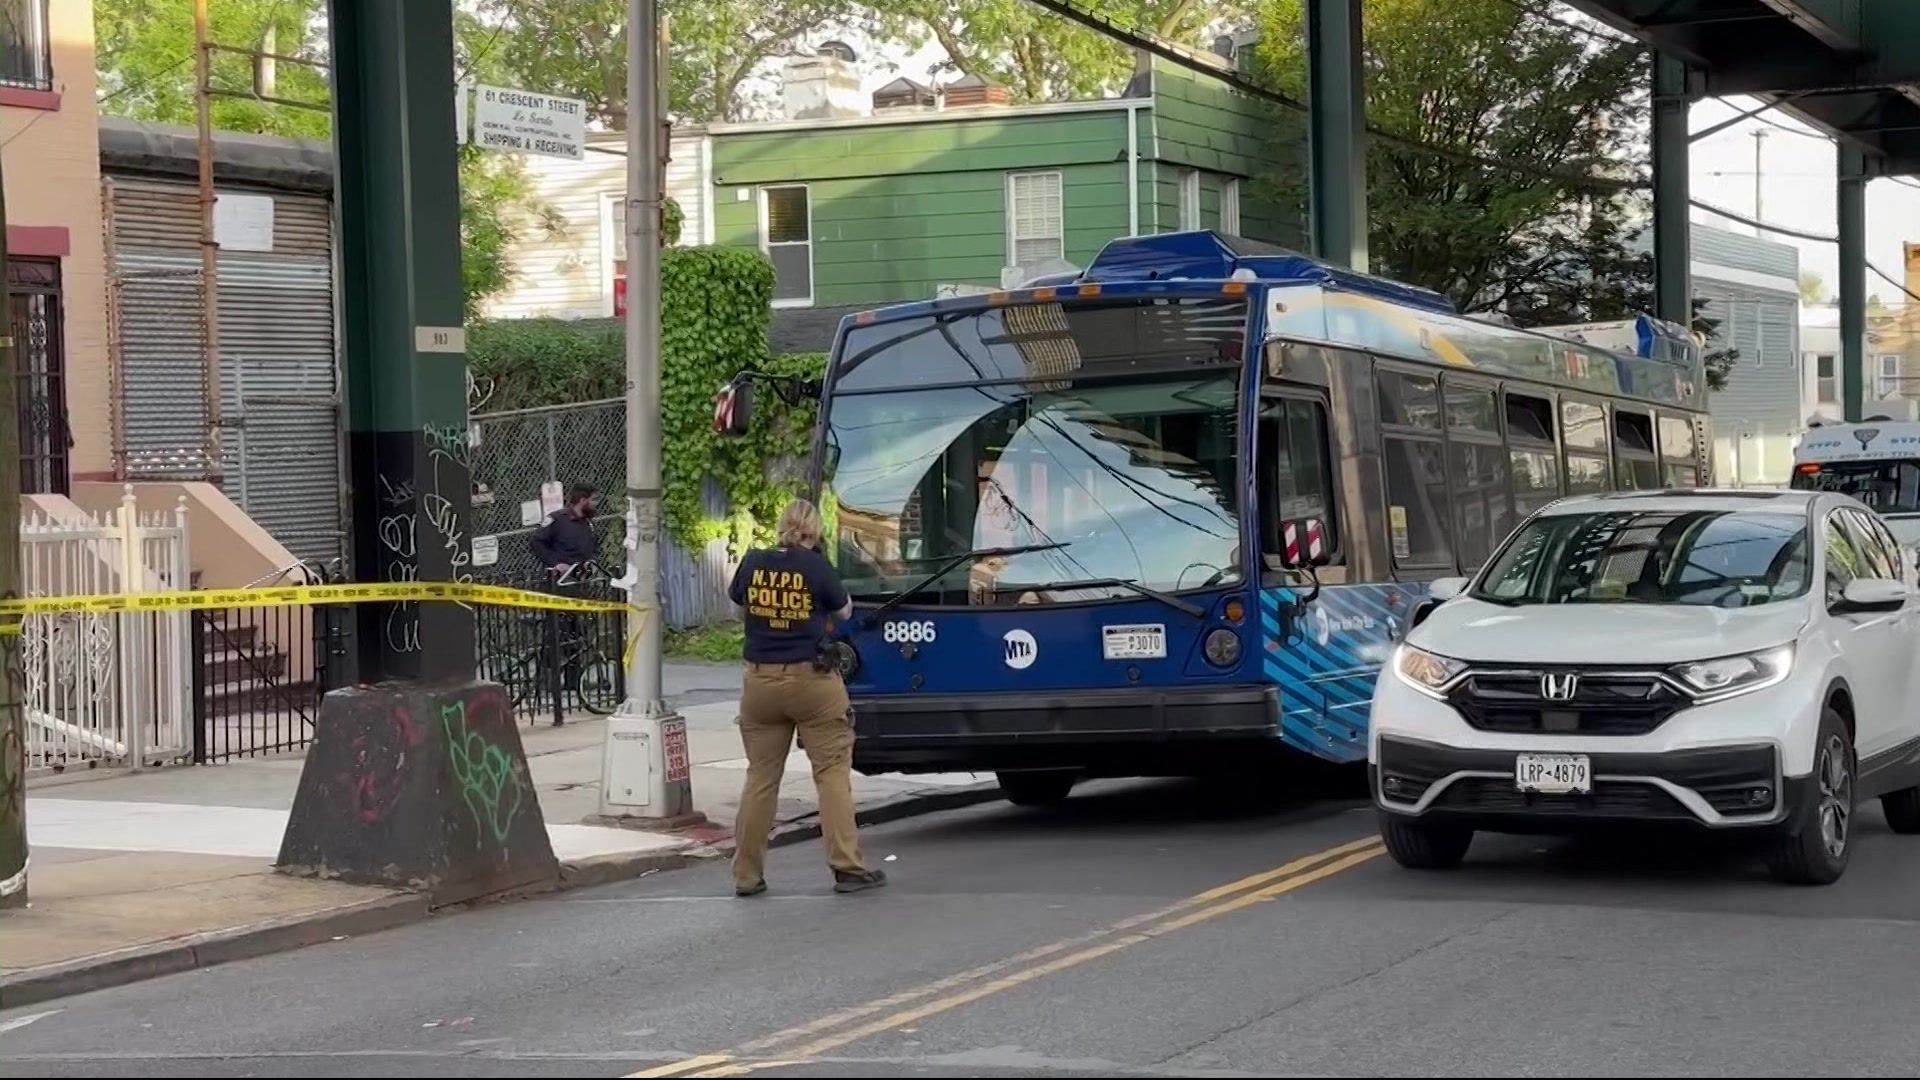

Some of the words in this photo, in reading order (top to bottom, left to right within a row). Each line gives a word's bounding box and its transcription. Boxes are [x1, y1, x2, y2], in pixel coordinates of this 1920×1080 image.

[485, 90, 495, 103] 61
[499, 92, 544, 109] CRESCENT
[549, 100, 579, 115] STREET
[483, 132, 522, 149] SHIPPING
[535, 139, 578, 157] RECEIVING
[747, 587, 813, 611] POLICE
[883, 620, 937, 643] 8886
[1002, 639, 1032, 660] MTA
